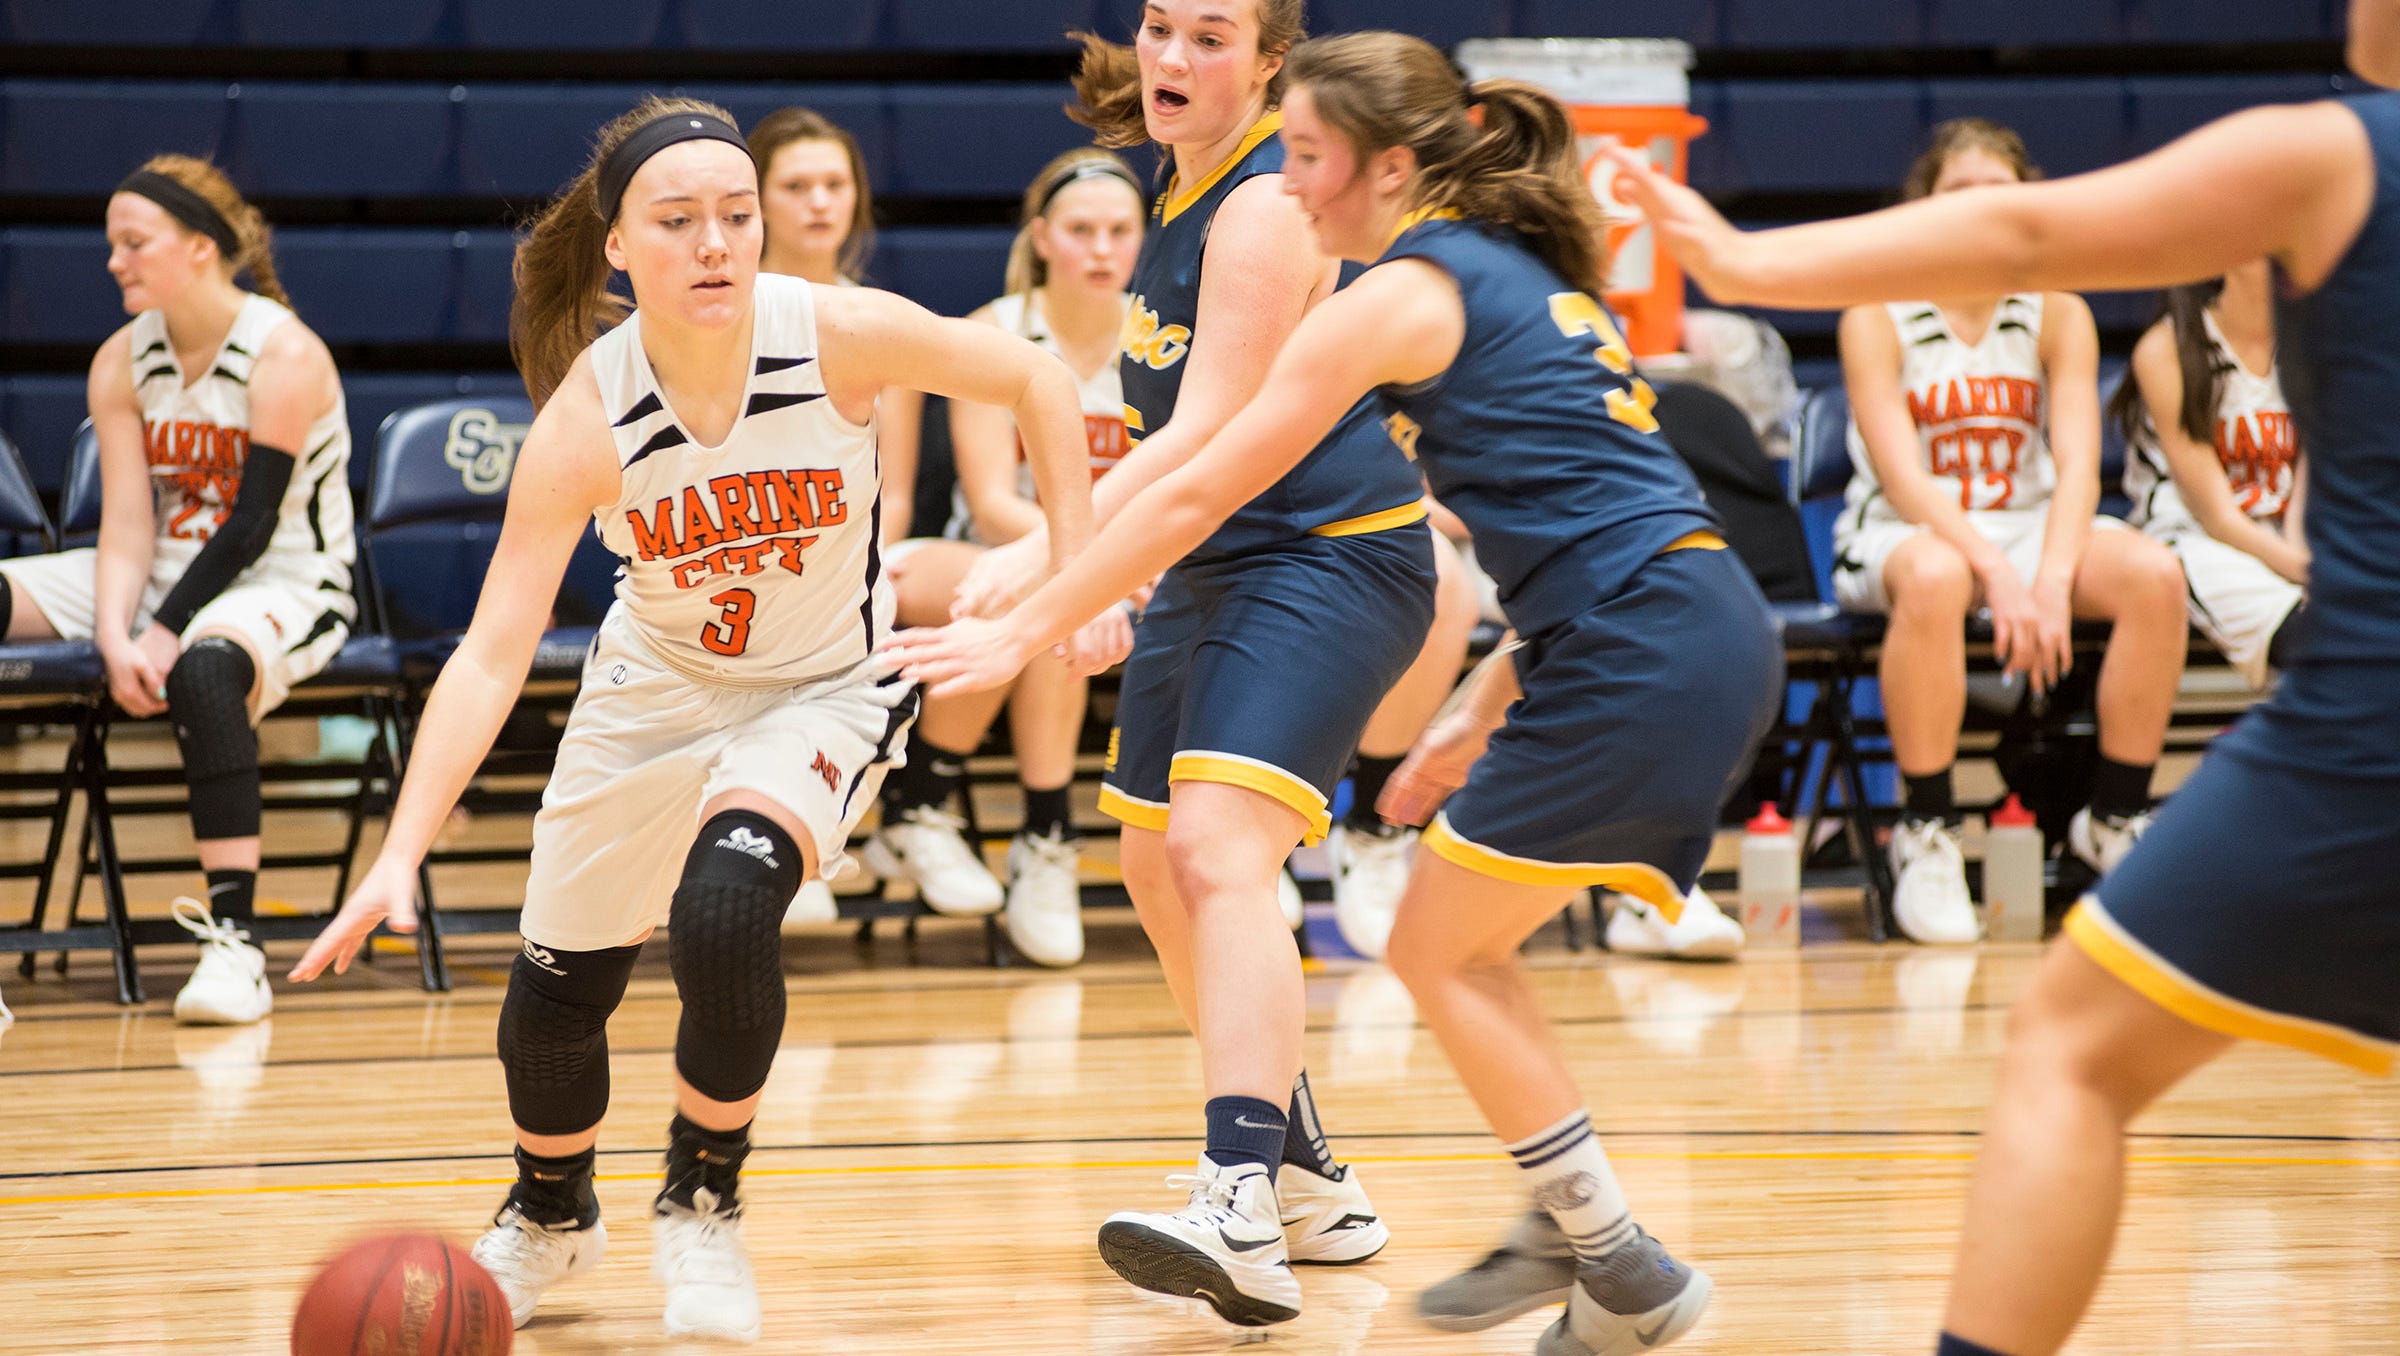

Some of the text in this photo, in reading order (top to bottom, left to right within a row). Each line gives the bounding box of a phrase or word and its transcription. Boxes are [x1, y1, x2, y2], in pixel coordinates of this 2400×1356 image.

[1930, 427, 2025, 476] CITY
[625, 467, 848, 562] MARINE
[1959, 471, 2014, 512] 12
[670, 534, 820, 589] CITY
[700, 587, 756, 657] 3
